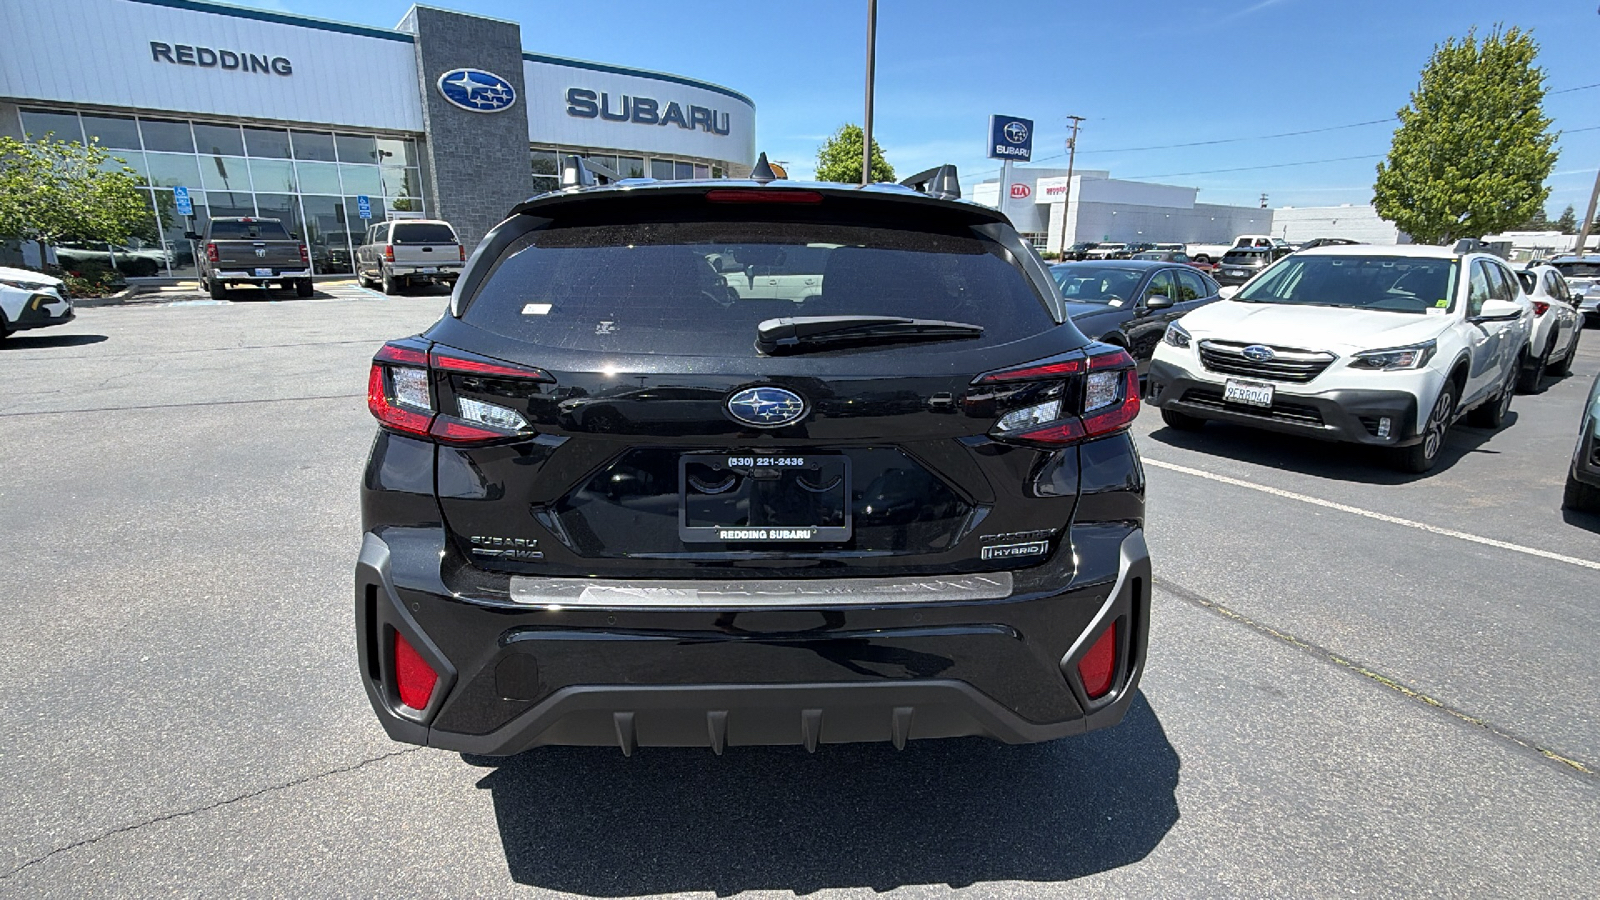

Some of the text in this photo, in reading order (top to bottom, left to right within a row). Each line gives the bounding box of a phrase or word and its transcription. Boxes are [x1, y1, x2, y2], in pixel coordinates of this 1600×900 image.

[150, 41, 293, 76] REDDING
[566, 87, 730, 136] SUBARU
[996, 144, 1030, 157] SUBARU
[1011, 185, 1028, 197] KIA
[728, 457, 804, 467] (530) 221-2436
[720, 530, 811, 539] REDDING SUBARU
[470, 535, 538, 547] SUBARU
[994, 546, 1039, 556] HYBRID
